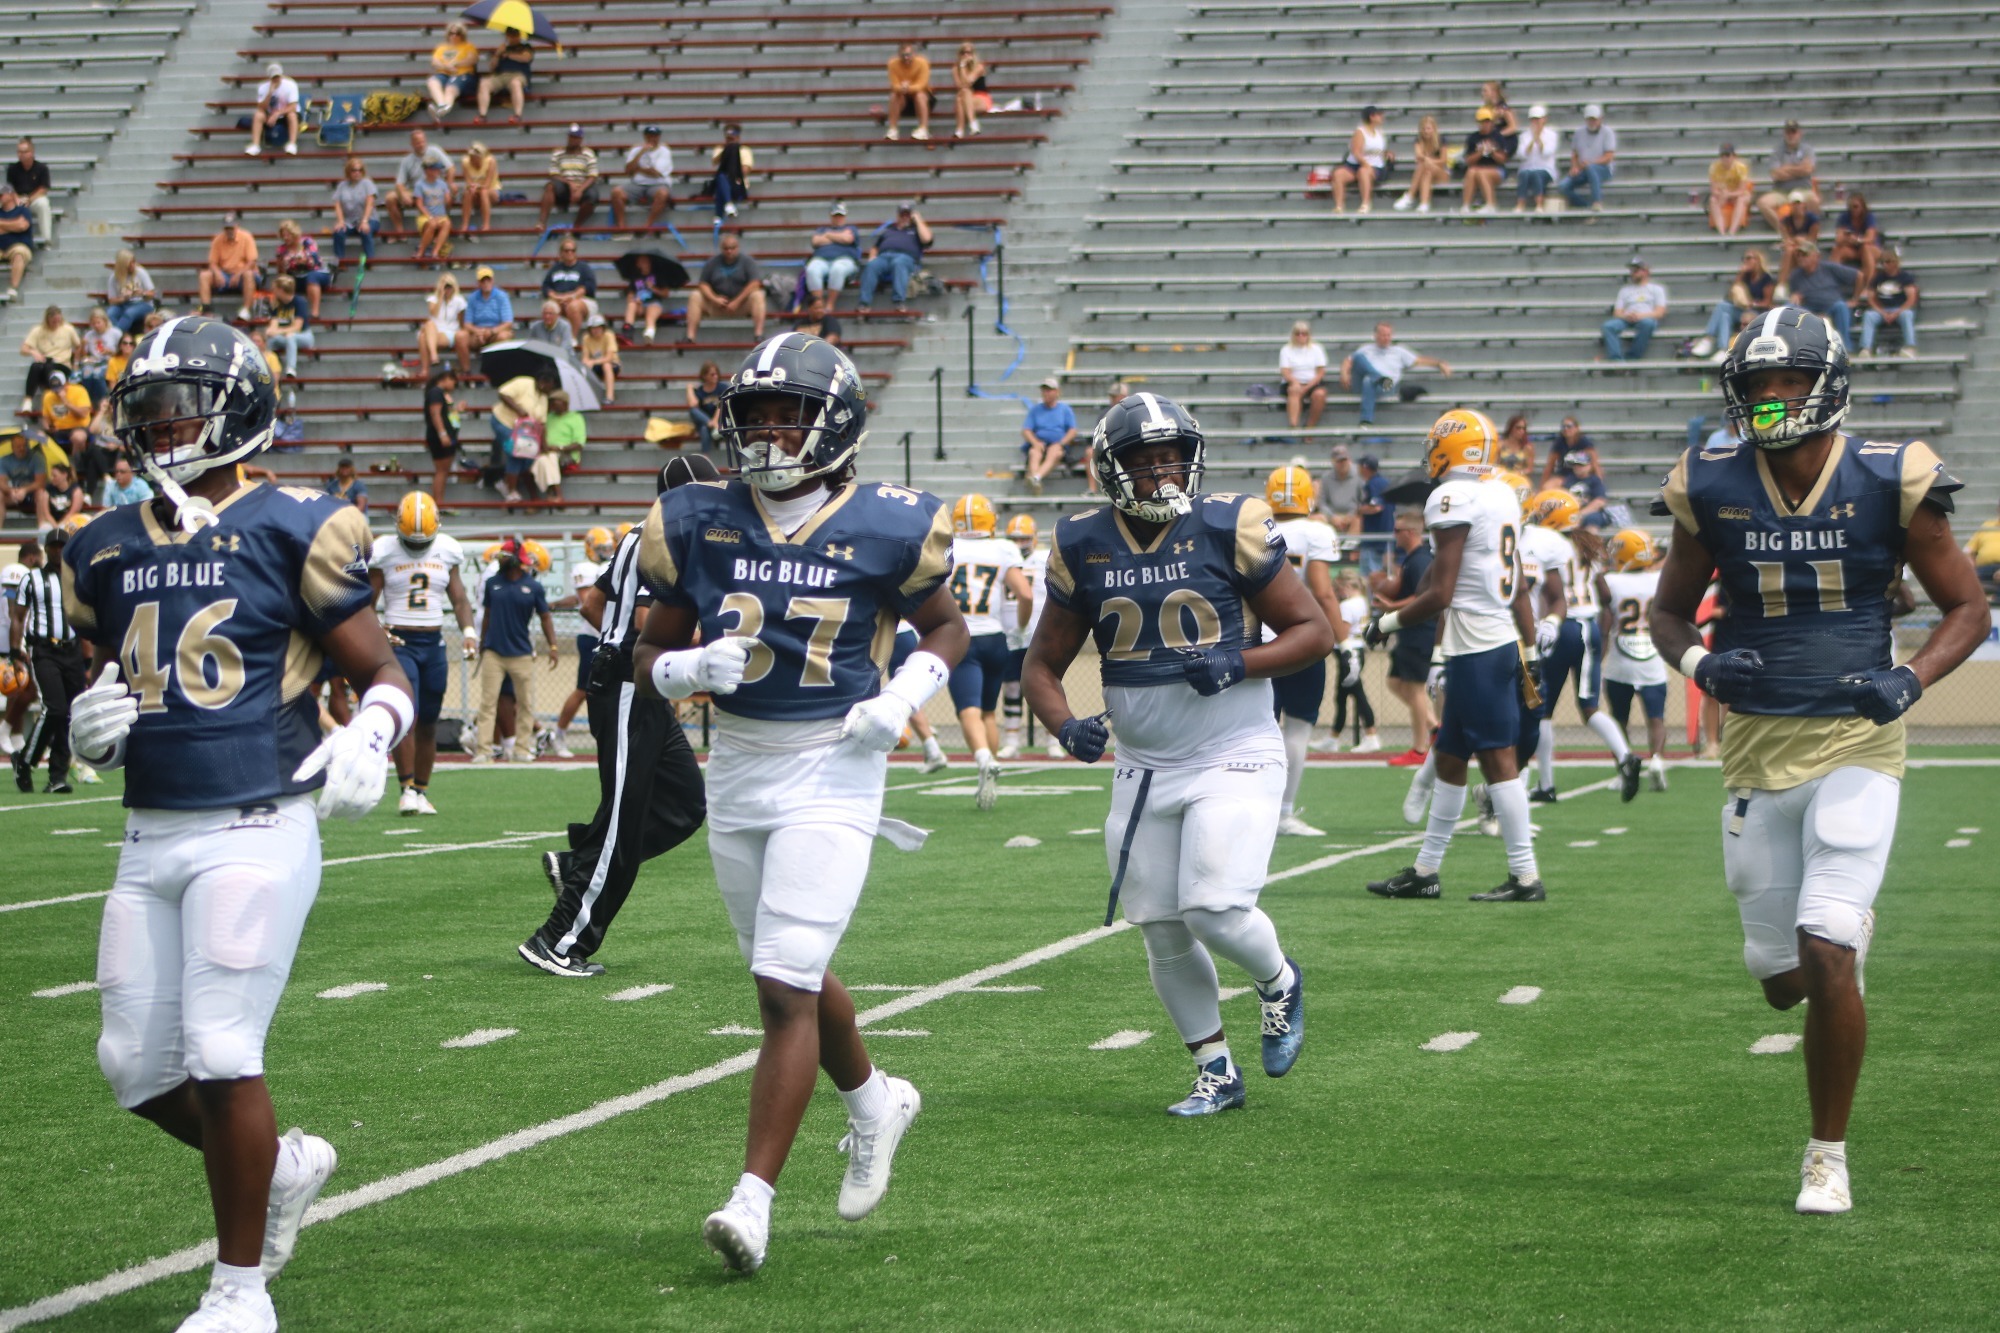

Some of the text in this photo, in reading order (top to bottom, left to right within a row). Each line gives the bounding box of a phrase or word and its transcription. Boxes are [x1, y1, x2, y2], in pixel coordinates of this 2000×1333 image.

[1718, 507, 1752, 520] CIAA
[705, 528, 741, 543] CIAA
[1744, 529, 1848, 550] BIG BLUE
[123, 562, 225, 594] BIG BLUE
[733, 558, 838, 588] BIG BLUE
[949, 563, 1001, 614] 47
[1104, 561, 1190, 588] BIG BLUE
[1748, 559, 1852, 618] 11
[407, 572, 429, 611] 2
[717, 592, 851, 687] 37
[1099, 588, 1221, 661] 20
[120, 598, 246, 714] 46
